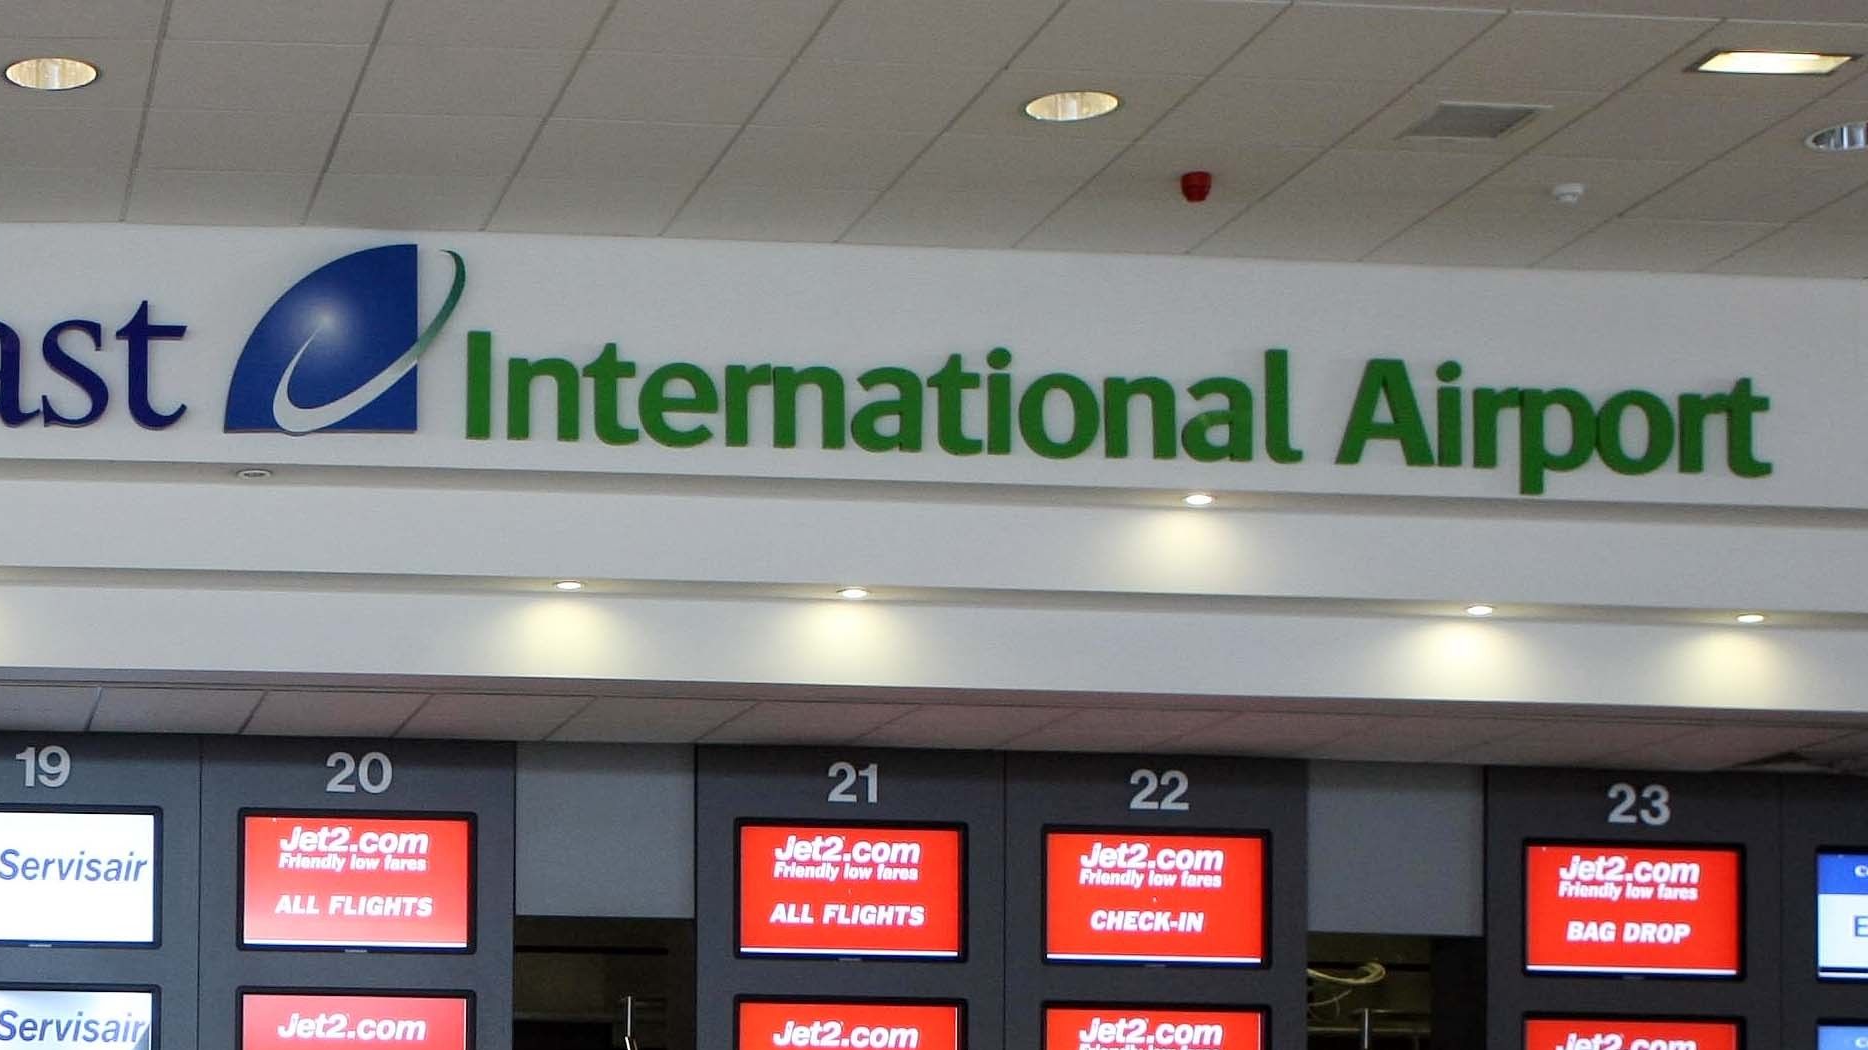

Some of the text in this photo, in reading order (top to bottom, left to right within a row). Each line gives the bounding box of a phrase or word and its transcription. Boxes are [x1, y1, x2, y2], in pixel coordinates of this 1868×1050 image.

[463, 329, 1303, 465] International
[1334, 356, 1775, 497] Airport
[15, 746, 72, 788] 19
[325, 751, 394, 794] 20
[827, 762, 879, 803] 21
[1129, 769, 1190, 811] 22
[1607, 783, 1671, 826] 23
[279, 826, 429, 855] Jet2.com
[773, 834, 921, 864] Jet2.com
[278, 852, 427, 874] Friendly low fares
[773, 861, 919, 881] Friendly low fares
[1080, 842, 1224, 872] Jet2.com
[1559, 854, 1700, 884] Jet2.com
[1079, 868, 1222, 888] Friendly low fares
[1558, 880, 1699, 901] Friendly low fares
[275, 895, 434, 918] ALL FLIGHTS
[770, 903, 926, 927] ALL FLIGHTS
[1089, 909, 1205, 933] CHECK-IN
[1566, 920, 1692, 944] BAG DROP
[277, 1012, 427, 1042] Jet2.com
[772, 1020, 919, 1049] Jet2.com
[1079, 1017, 1223, 1047] Jet2.com
